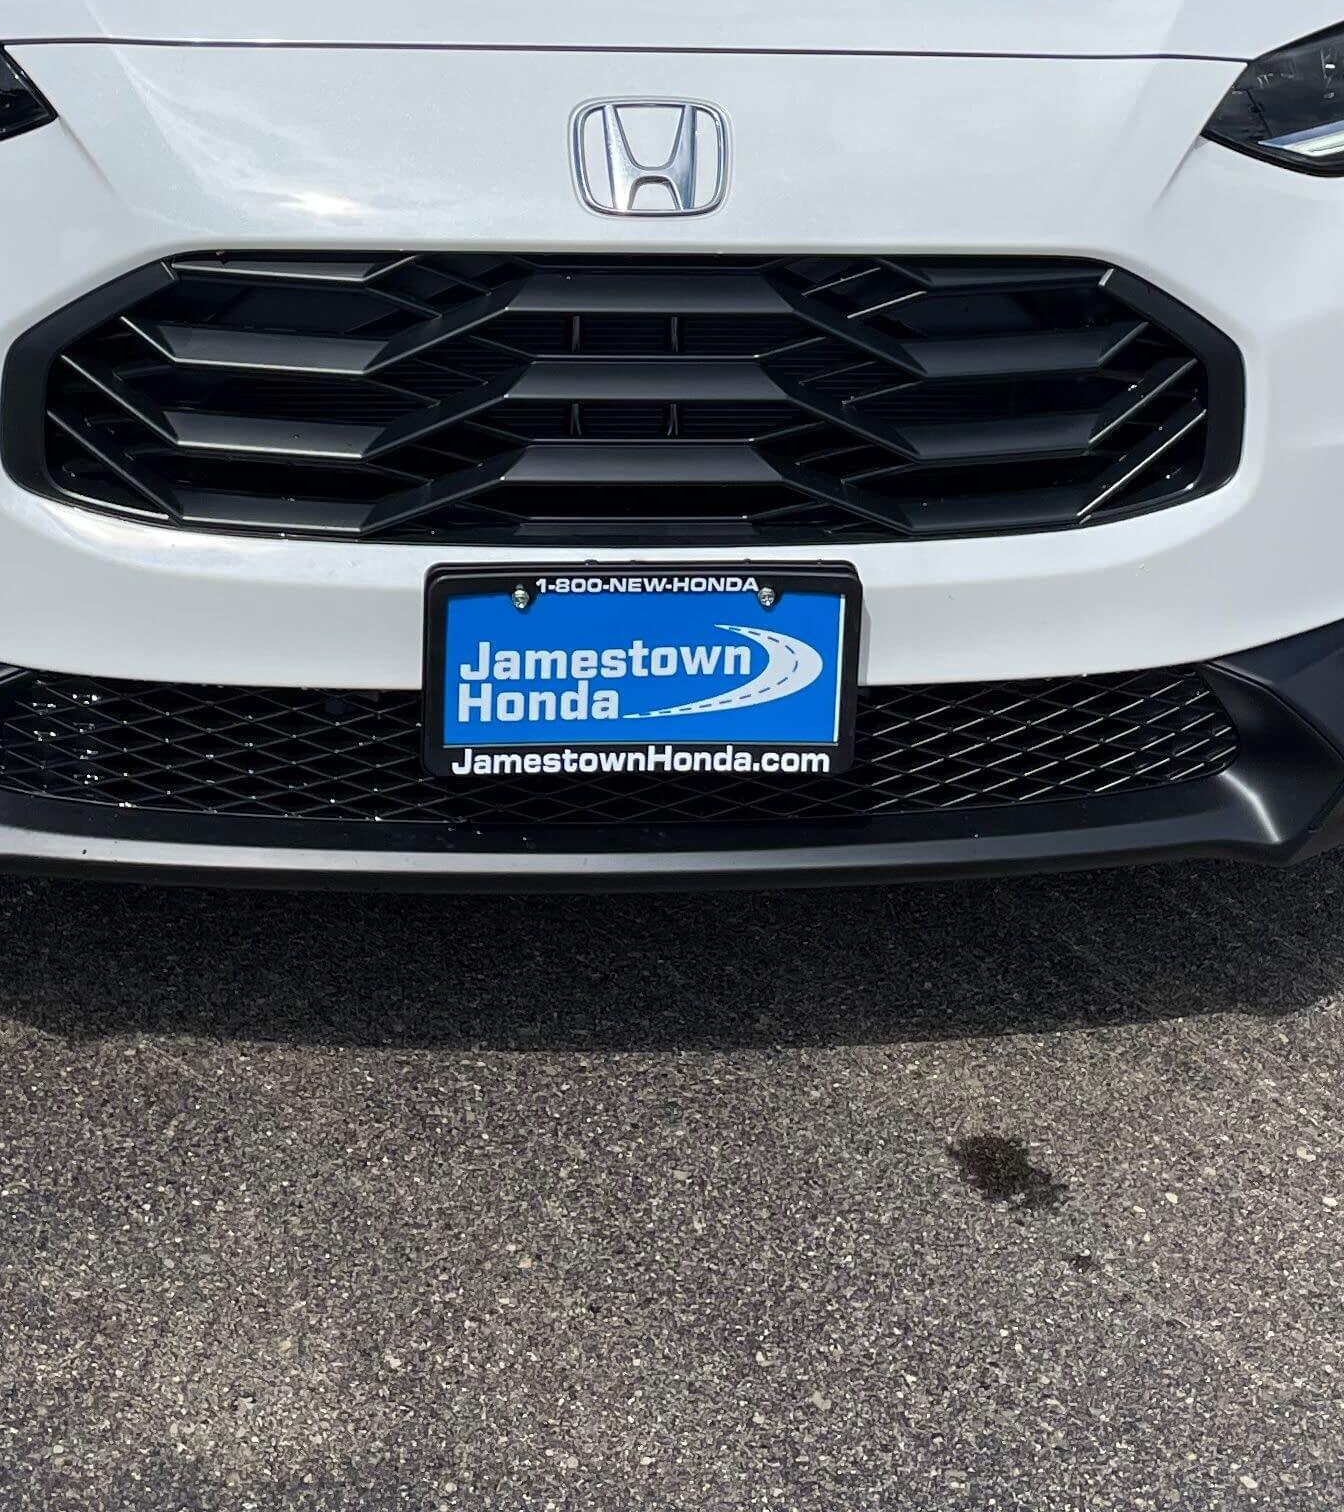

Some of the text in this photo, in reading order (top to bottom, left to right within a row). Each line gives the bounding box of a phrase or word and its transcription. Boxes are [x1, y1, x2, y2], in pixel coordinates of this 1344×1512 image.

[535, 577, 759, 593] 1-800-NEW-HONDA
[459, 639, 751, 681] Jamestown
[458, 680, 619, 722] Honda
[451, 745, 830, 775] JamestownHonda.com
